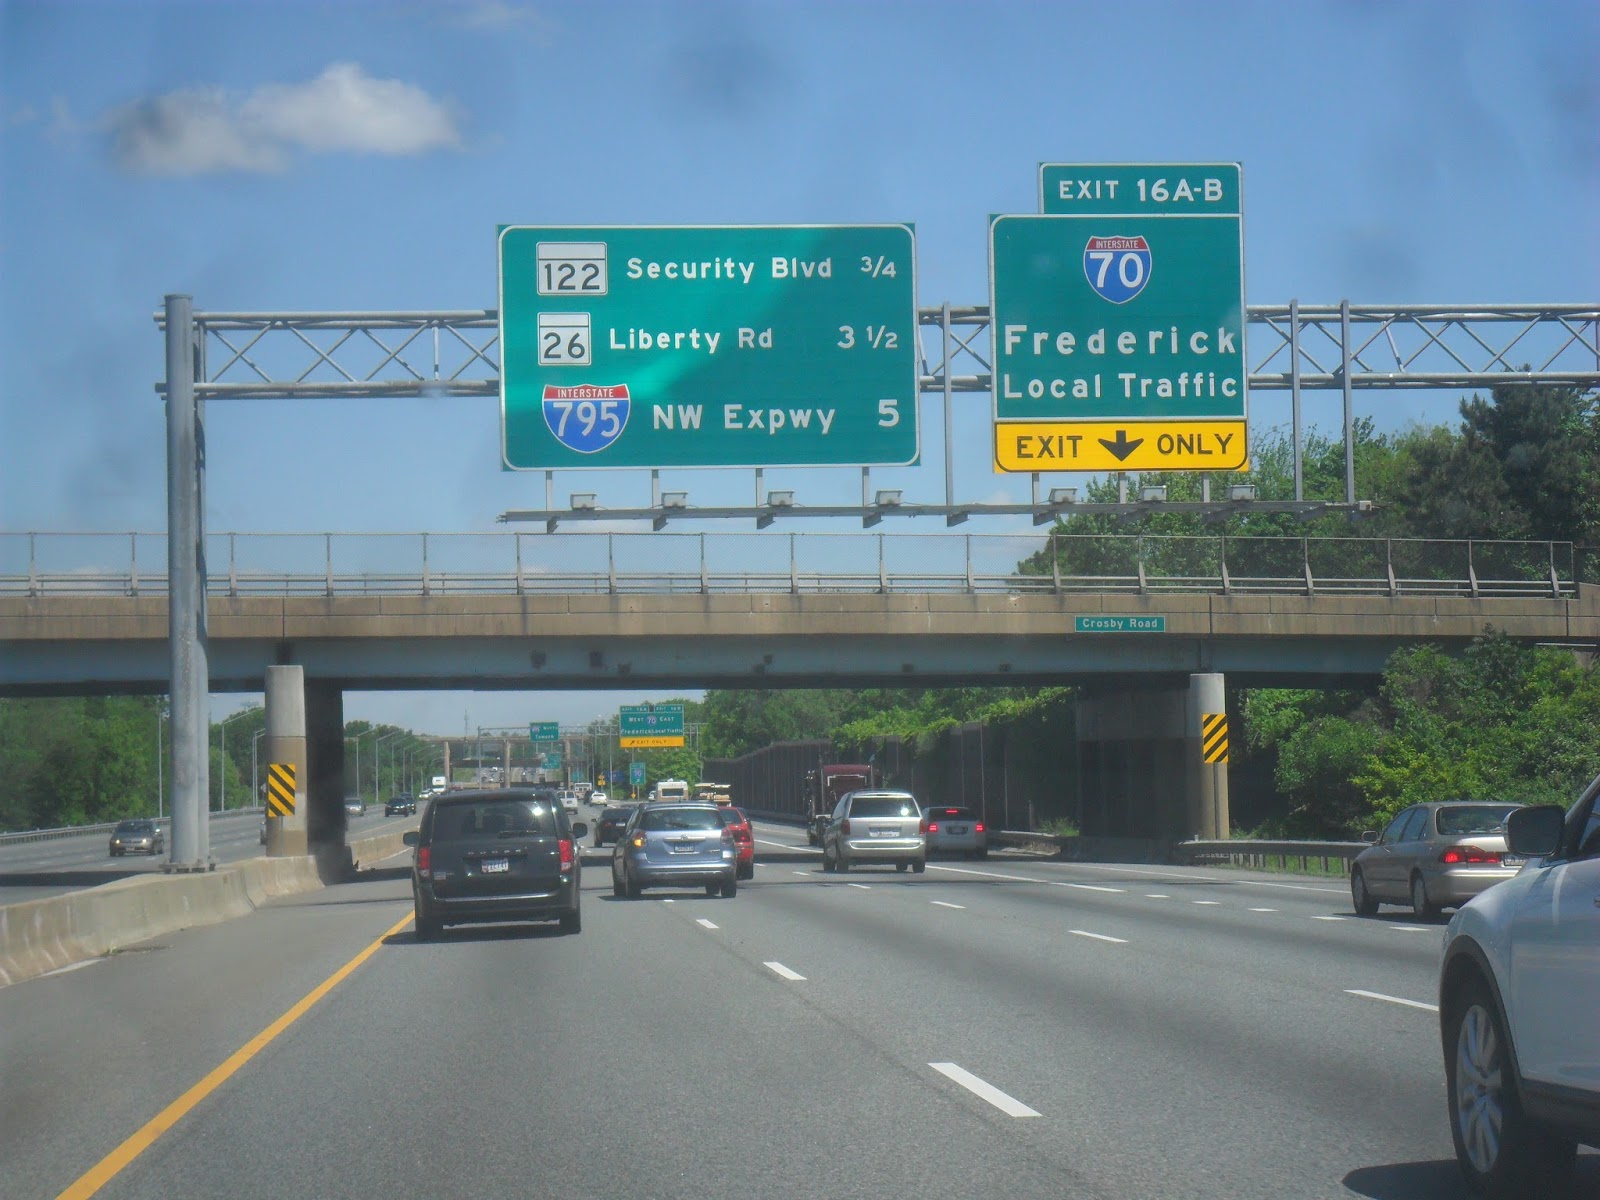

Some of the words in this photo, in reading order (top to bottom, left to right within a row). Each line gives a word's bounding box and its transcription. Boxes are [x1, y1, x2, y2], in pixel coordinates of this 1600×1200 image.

[1060, 180, 1119, 199] EXIT
[1137, 178, 1223, 201] 16A-B
[1095, 239, 1139, 249] INTERSTATE
[544, 263, 600, 290] 122
[627, 257, 754, 283] Security
[772, 257, 832, 278] Blvd
[1089, 252, 1144, 288] 70
[543, 332, 586, 359] 26
[610, 327, 720, 353] Liberty
[739, 327, 773, 348] Rd
[837, 326, 855, 349] 3
[1004, 324, 1236, 355] Frederick
[557, 388, 614, 398] INTERSTATE
[1004, 373, 1101, 399] Local
[1118, 372, 1237, 398] Traffic
[553, 401, 620, 437] 795
[653, 404, 703, 429] NW
[724, 404, 835, 434] Expwy
[878, 399, 899, 427] 5
[1017, 435, 1083, 459] EXIT
[1157, 433, 1233, 455] ONLY
[1082, 618, 1123, 629] Crosby
[1129, 618, 1158, 628] Road
